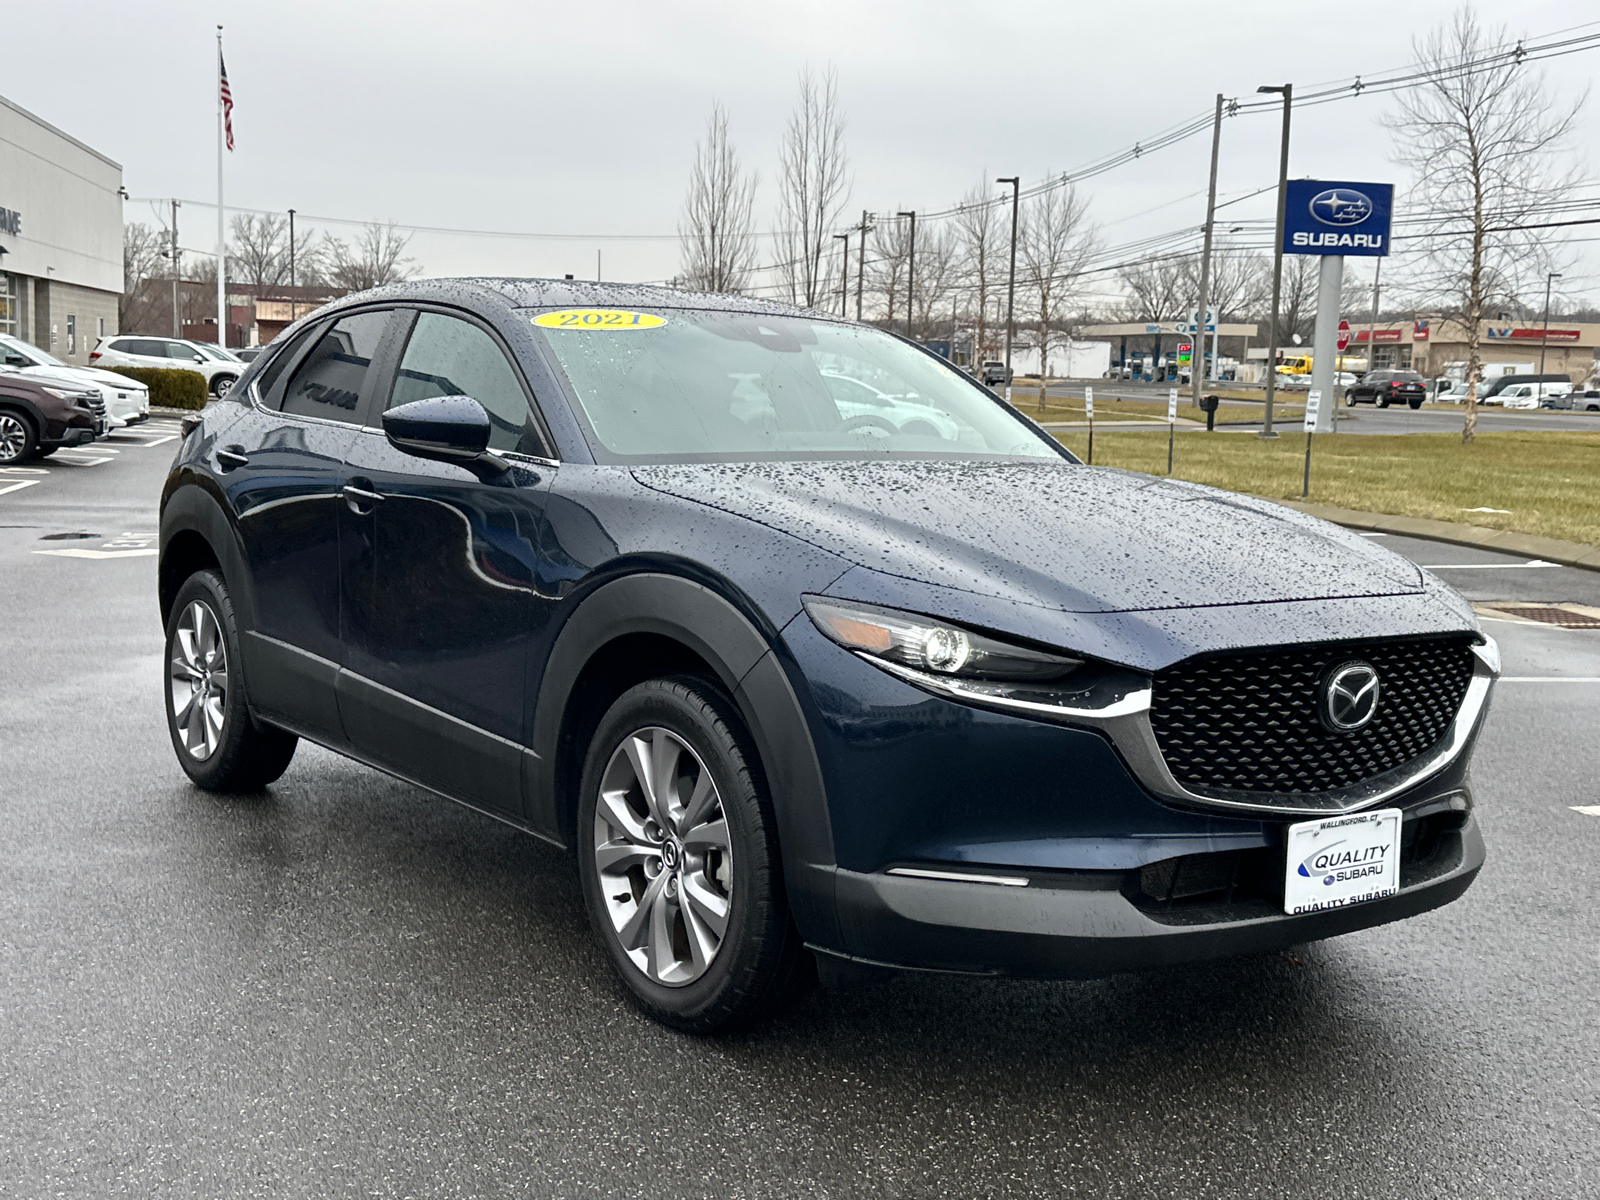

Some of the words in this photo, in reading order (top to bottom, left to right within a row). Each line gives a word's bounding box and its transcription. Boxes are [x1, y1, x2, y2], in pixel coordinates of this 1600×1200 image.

[1293, 232, 1382, 248] SUBARU
[560, 313, 642, 326] 2021
[1337, 329, 1349, 341] STOP
[1370, 814, 1379, 822] CT
[1315, 844, 1390, 869] QUALITY
[1336, 865, 1383, 882] SUBARU
[1293, 898, 1345, 915] QUALITY
[1350, 887, 1396, 904] SUBARU
